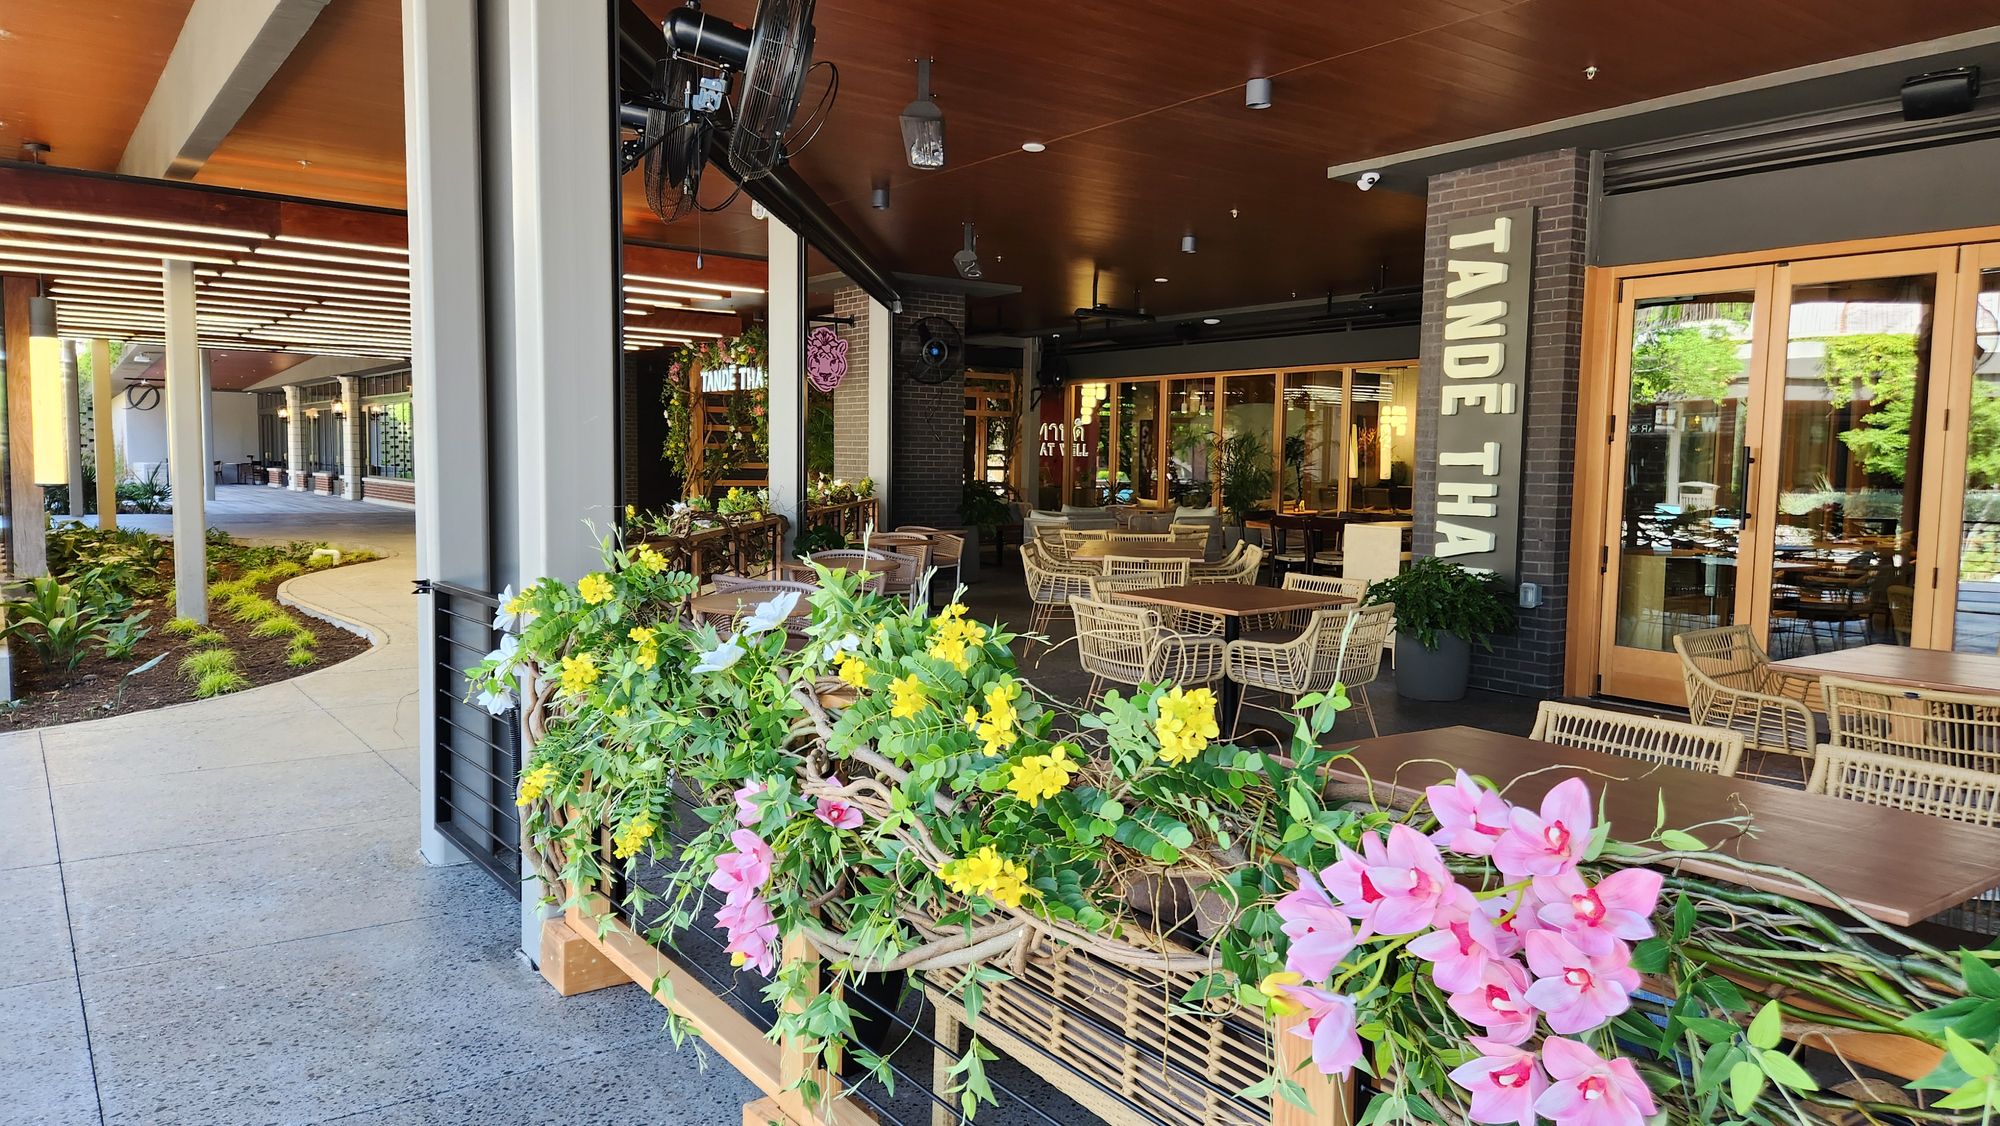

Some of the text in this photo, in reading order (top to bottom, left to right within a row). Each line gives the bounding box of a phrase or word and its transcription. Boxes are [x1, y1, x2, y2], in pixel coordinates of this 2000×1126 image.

[1441, 217, 1516, 416] TANDĒ
[700, 364, 768, 392] TANDĒ THA
